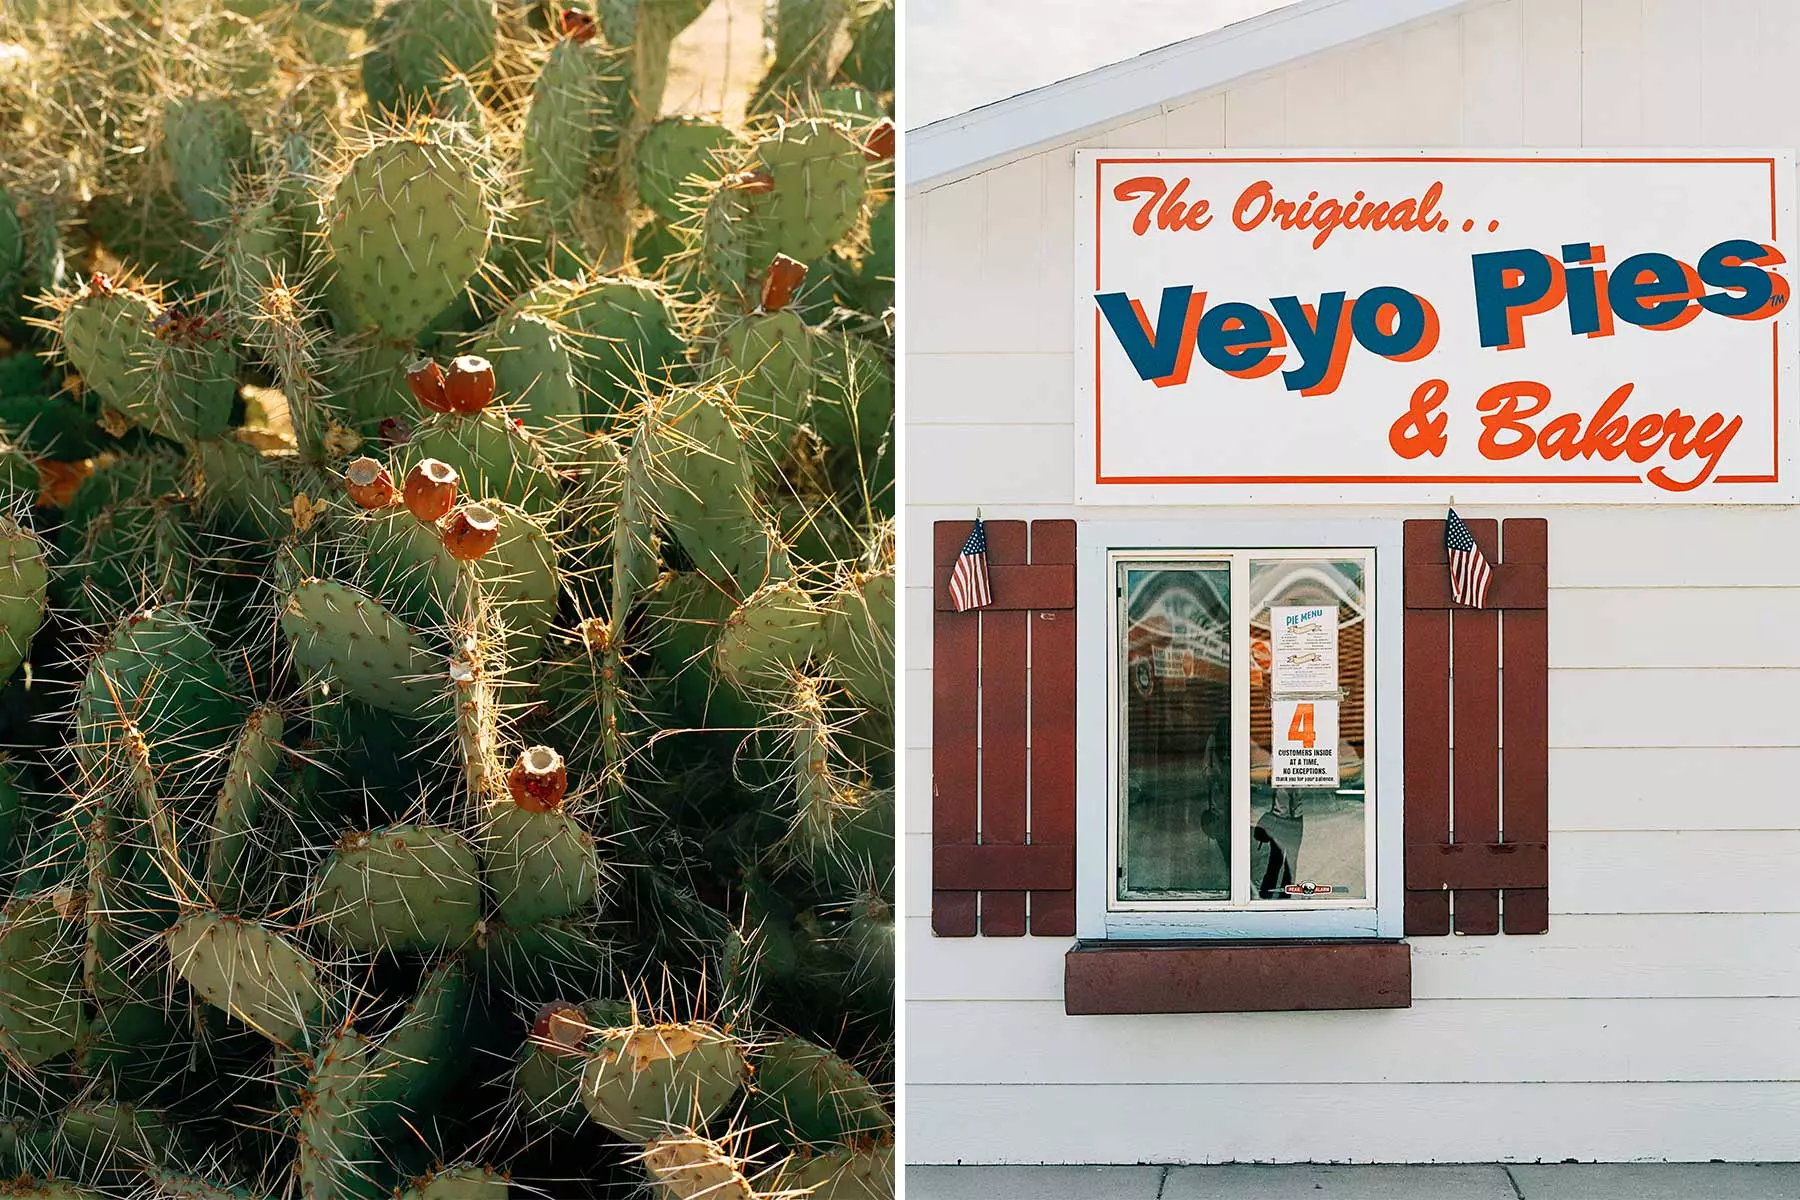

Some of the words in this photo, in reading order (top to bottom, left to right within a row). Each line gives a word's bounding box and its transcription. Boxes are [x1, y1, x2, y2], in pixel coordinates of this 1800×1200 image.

[1113, 176, 1213, 235] The
[1094, 285, 1440, 397] Veyo
[1471, 239, 1790, 352] Pies
[1388, 378, 1449, 460] &
[1475, 382, 1743, 492] Bakery
[1286, 614, 1299, 626] PIE
[1300, 609, 1323, 622] MENU
[1288, 703, 1316, 748] 4
[1278, 749, 1313, 757] CUSTOMERS
[1313, 749, 1332, 757] INSIDE
[1289, 758, 1297, 766] AT
[1297, 758, 1302, 766] A
